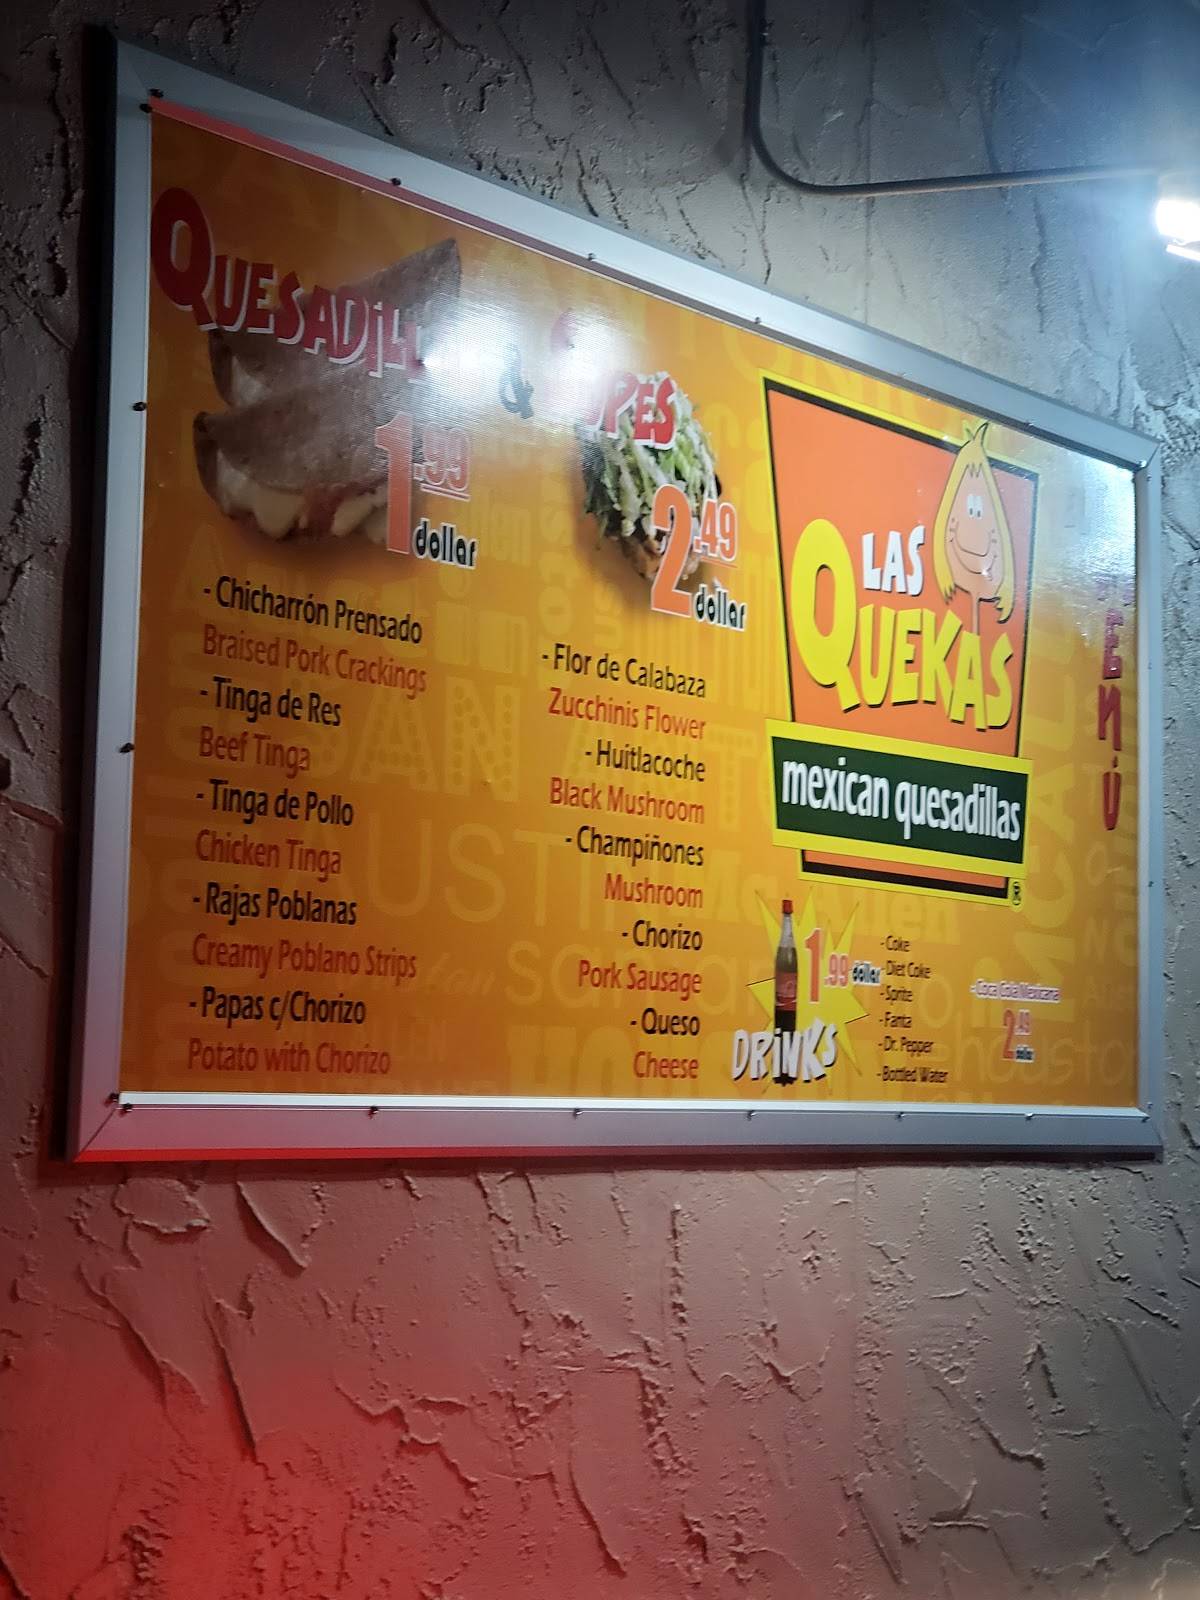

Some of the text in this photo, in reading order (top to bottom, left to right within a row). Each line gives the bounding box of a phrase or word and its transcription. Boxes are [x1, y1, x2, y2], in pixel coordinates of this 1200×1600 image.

[414, 519, 477, 569] dollar
[861, 524, 925, 596] LAS
[216, 576, 328, 626] Chicharrón
[335, 600, 422, 644] Prensado
[695, 583, 747, 631] dollar
[790, 518, 1014, 731] QUEKAS
[204, 623, 427, 700] Braised Pork Crackings
[553, 643, 706, 698] Flor de Calabaza
[213, 676, 341, 726] Tinga de Res
[548, 687, 706, 740] Zucchinis Flower
[200, 726, 310, 779] Beef Tinga
[596, 739, 706, 782] Huitlacoche
[210, 779, 354, 826] Tinga de Pollo
[550, 777, 704, 824] Black Mushroom
[781, 756, 1021, 841] mexican quesadillas
[196, 828, 341, 883] Chicken Tinga
[577, 825, 704, 867] Champiñones
[206, 882, 357, 926] Rajas Poblanas
[605, 873, 703, 908] Mushroom
[633, 920, 703, 951] Chorizo
[886, 935, 910, 952] Coke
[192, 933, 273, 979] Creamy
[278, 939, 360, 975] Poblano
[365, 945, 417, 987] Strips
[578, 959, 622, 989] Pork
[627, 963, 702, 1001] Sausage
[886, 960, 932, 979] Diet Coke
[202, 986, 366, 1030] Papas c/Chorizo
[885, 985, 913, 1005] Sprite
[641, 1008, 700, 1036] Queso
[187, 1038, 392, 1074] Potato with Chorizo
[633, 1051, 698, 1079] Cheese
[900, 1037, 934, 1057] Pepper
[919, 1066, 949, 1083] Water
